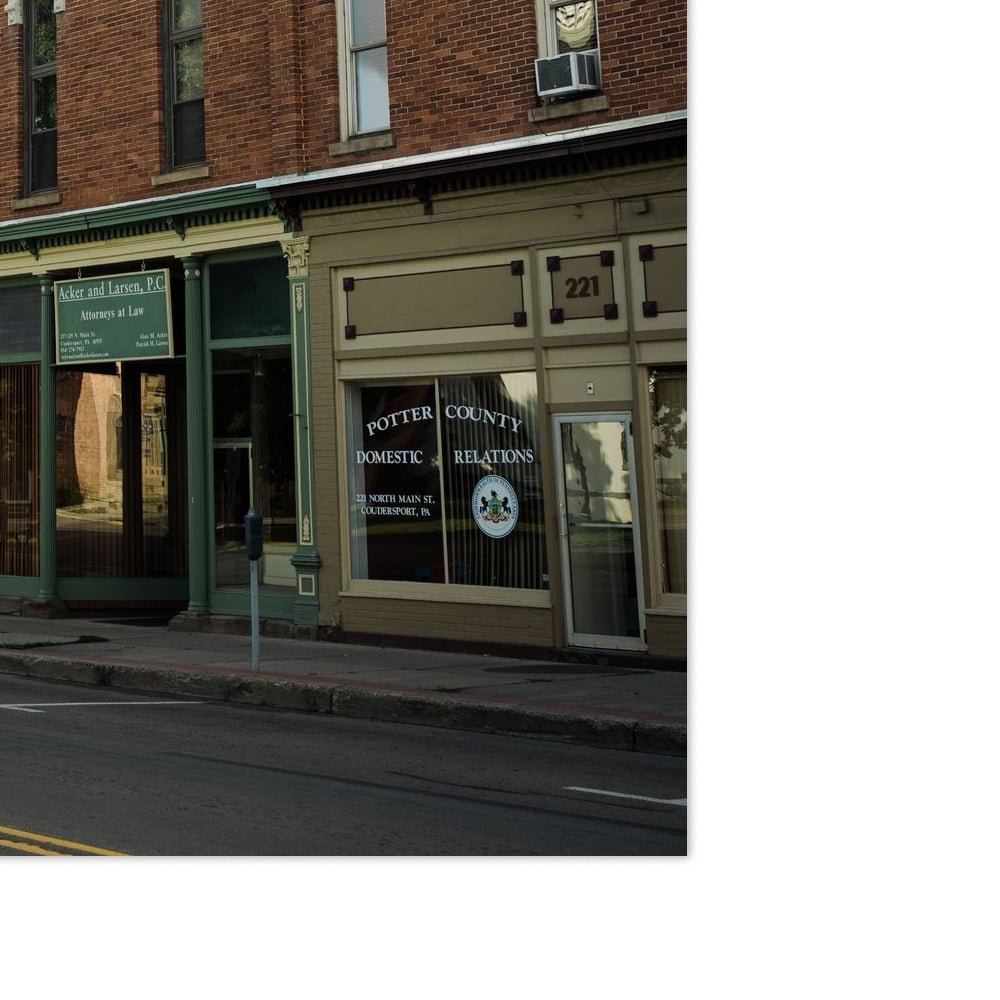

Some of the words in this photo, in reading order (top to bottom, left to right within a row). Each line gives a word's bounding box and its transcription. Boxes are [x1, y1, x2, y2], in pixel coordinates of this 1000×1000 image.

[59, 285, 84, 300] Acker
[88, 281, 105, 297] and
[108, 281, 143, 296] Larsen,
[565, 276, 599, 299] 221
[81, 309, 115, 320] Attorneys
[118, 308, 125, 317] at
[128, 306, 144, 317] Law
[366, 405, 434, 436] POTTER
[445, 405, 523, 433] COUNTY
[356, 450, 423, 464] DOMESTIC
[454, 449, 534, 464] RELATIONS
[356, 494, 365, 502] 221
[368, 494, 396, 503] NORTH
[398, 495, 421, 503] MAIN
[423, 496, 435, 504] ST.
[361, 506, 419, 517] COUDERSPORT,
[421, 508, 431, 516] PA
